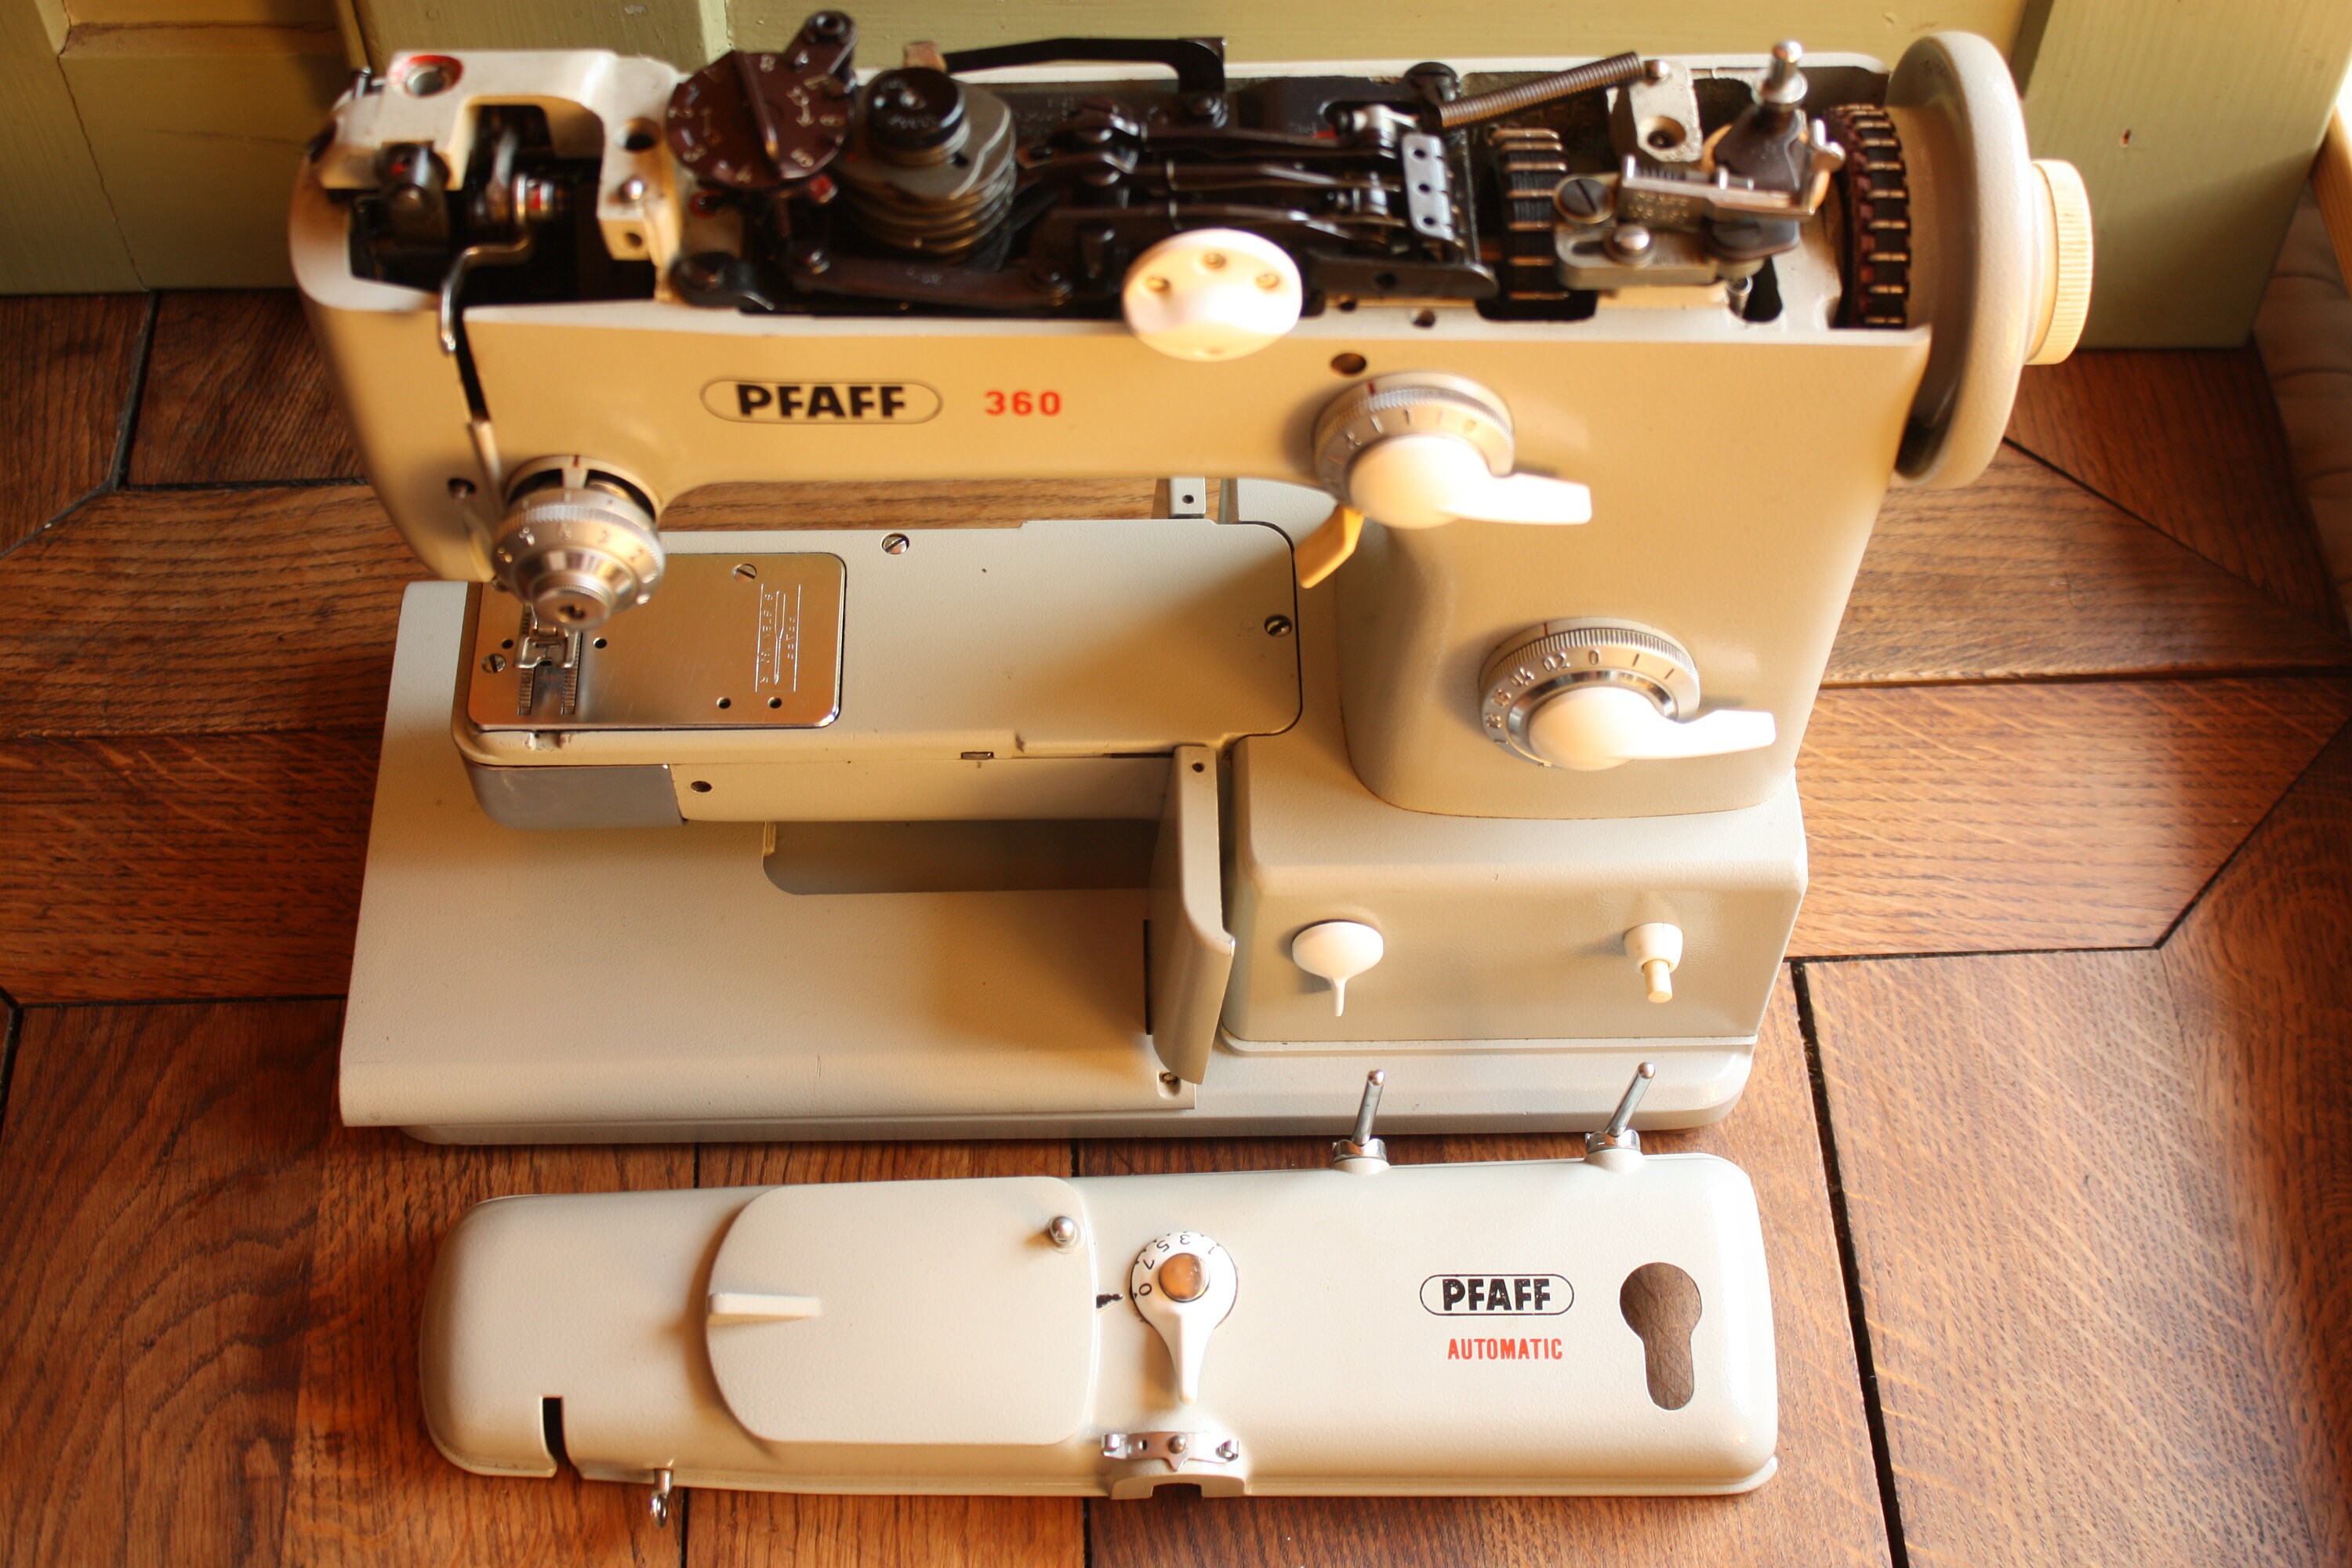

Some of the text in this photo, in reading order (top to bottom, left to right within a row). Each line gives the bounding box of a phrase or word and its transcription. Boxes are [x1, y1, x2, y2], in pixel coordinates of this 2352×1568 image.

[735, 384, 905, 419] PFAFF
[985, 390, 1062, 416] 360
[1588, 649, 1600, 665] 0
[1156, 1240, 1170, 1252] 5
[1179, 1234, 1191, 1245] 3
[1142, 1259, 1155, 1271] 7
[1138, 1283, 1152, 1296] 0
[1442, 1278, 1551, 1311] PFAFF
[1447, 1338, 1563, 1360] AUTOMATIC
